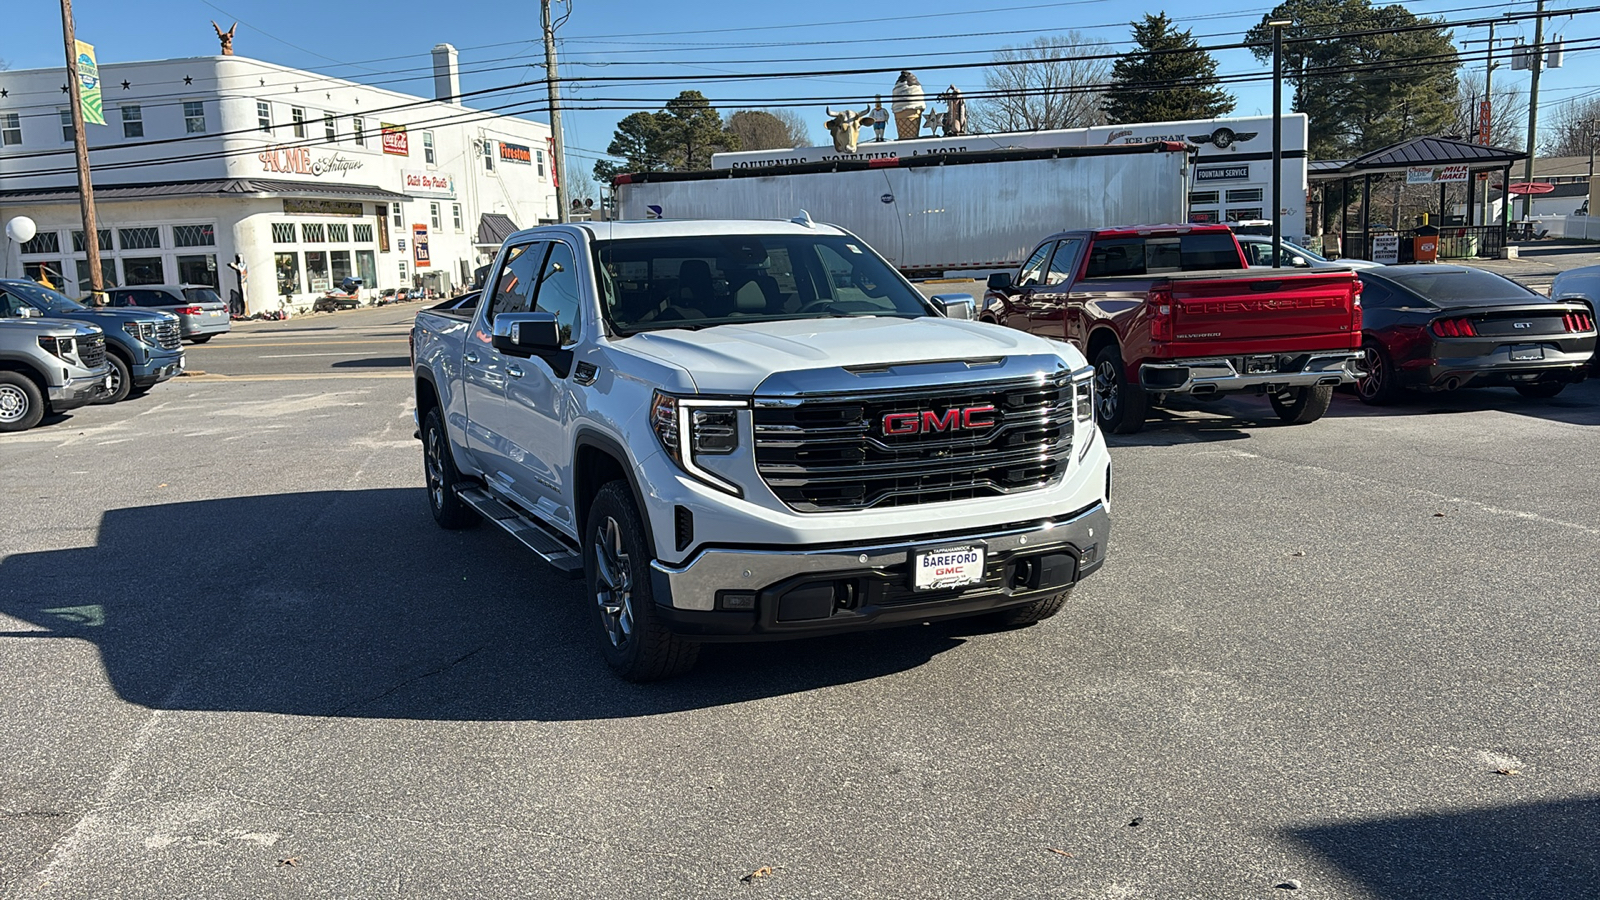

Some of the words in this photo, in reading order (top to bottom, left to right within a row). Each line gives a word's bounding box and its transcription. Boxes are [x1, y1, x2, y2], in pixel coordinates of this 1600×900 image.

[1125, 136, 1142, 144] ICE
[1144, 134, 1185, 144] CREAM
[258, 143, 312, 175] ACME
[312, 151, 363, 178] Antiques
[1198, 170, 1224, 179] FOUNTAIN
[1225, 168, 1248, 177] SERVICE
[1438, 172, 1467, 180] SHAKES
[422, 175, 432, 189] Boy
[1186, 298, 1342, 314] CHEVROLET
[882, 405, 996, 436] GMC
[923, 553, 978, 568] BAREFORD
[935, 566, 964, 576] GMC
